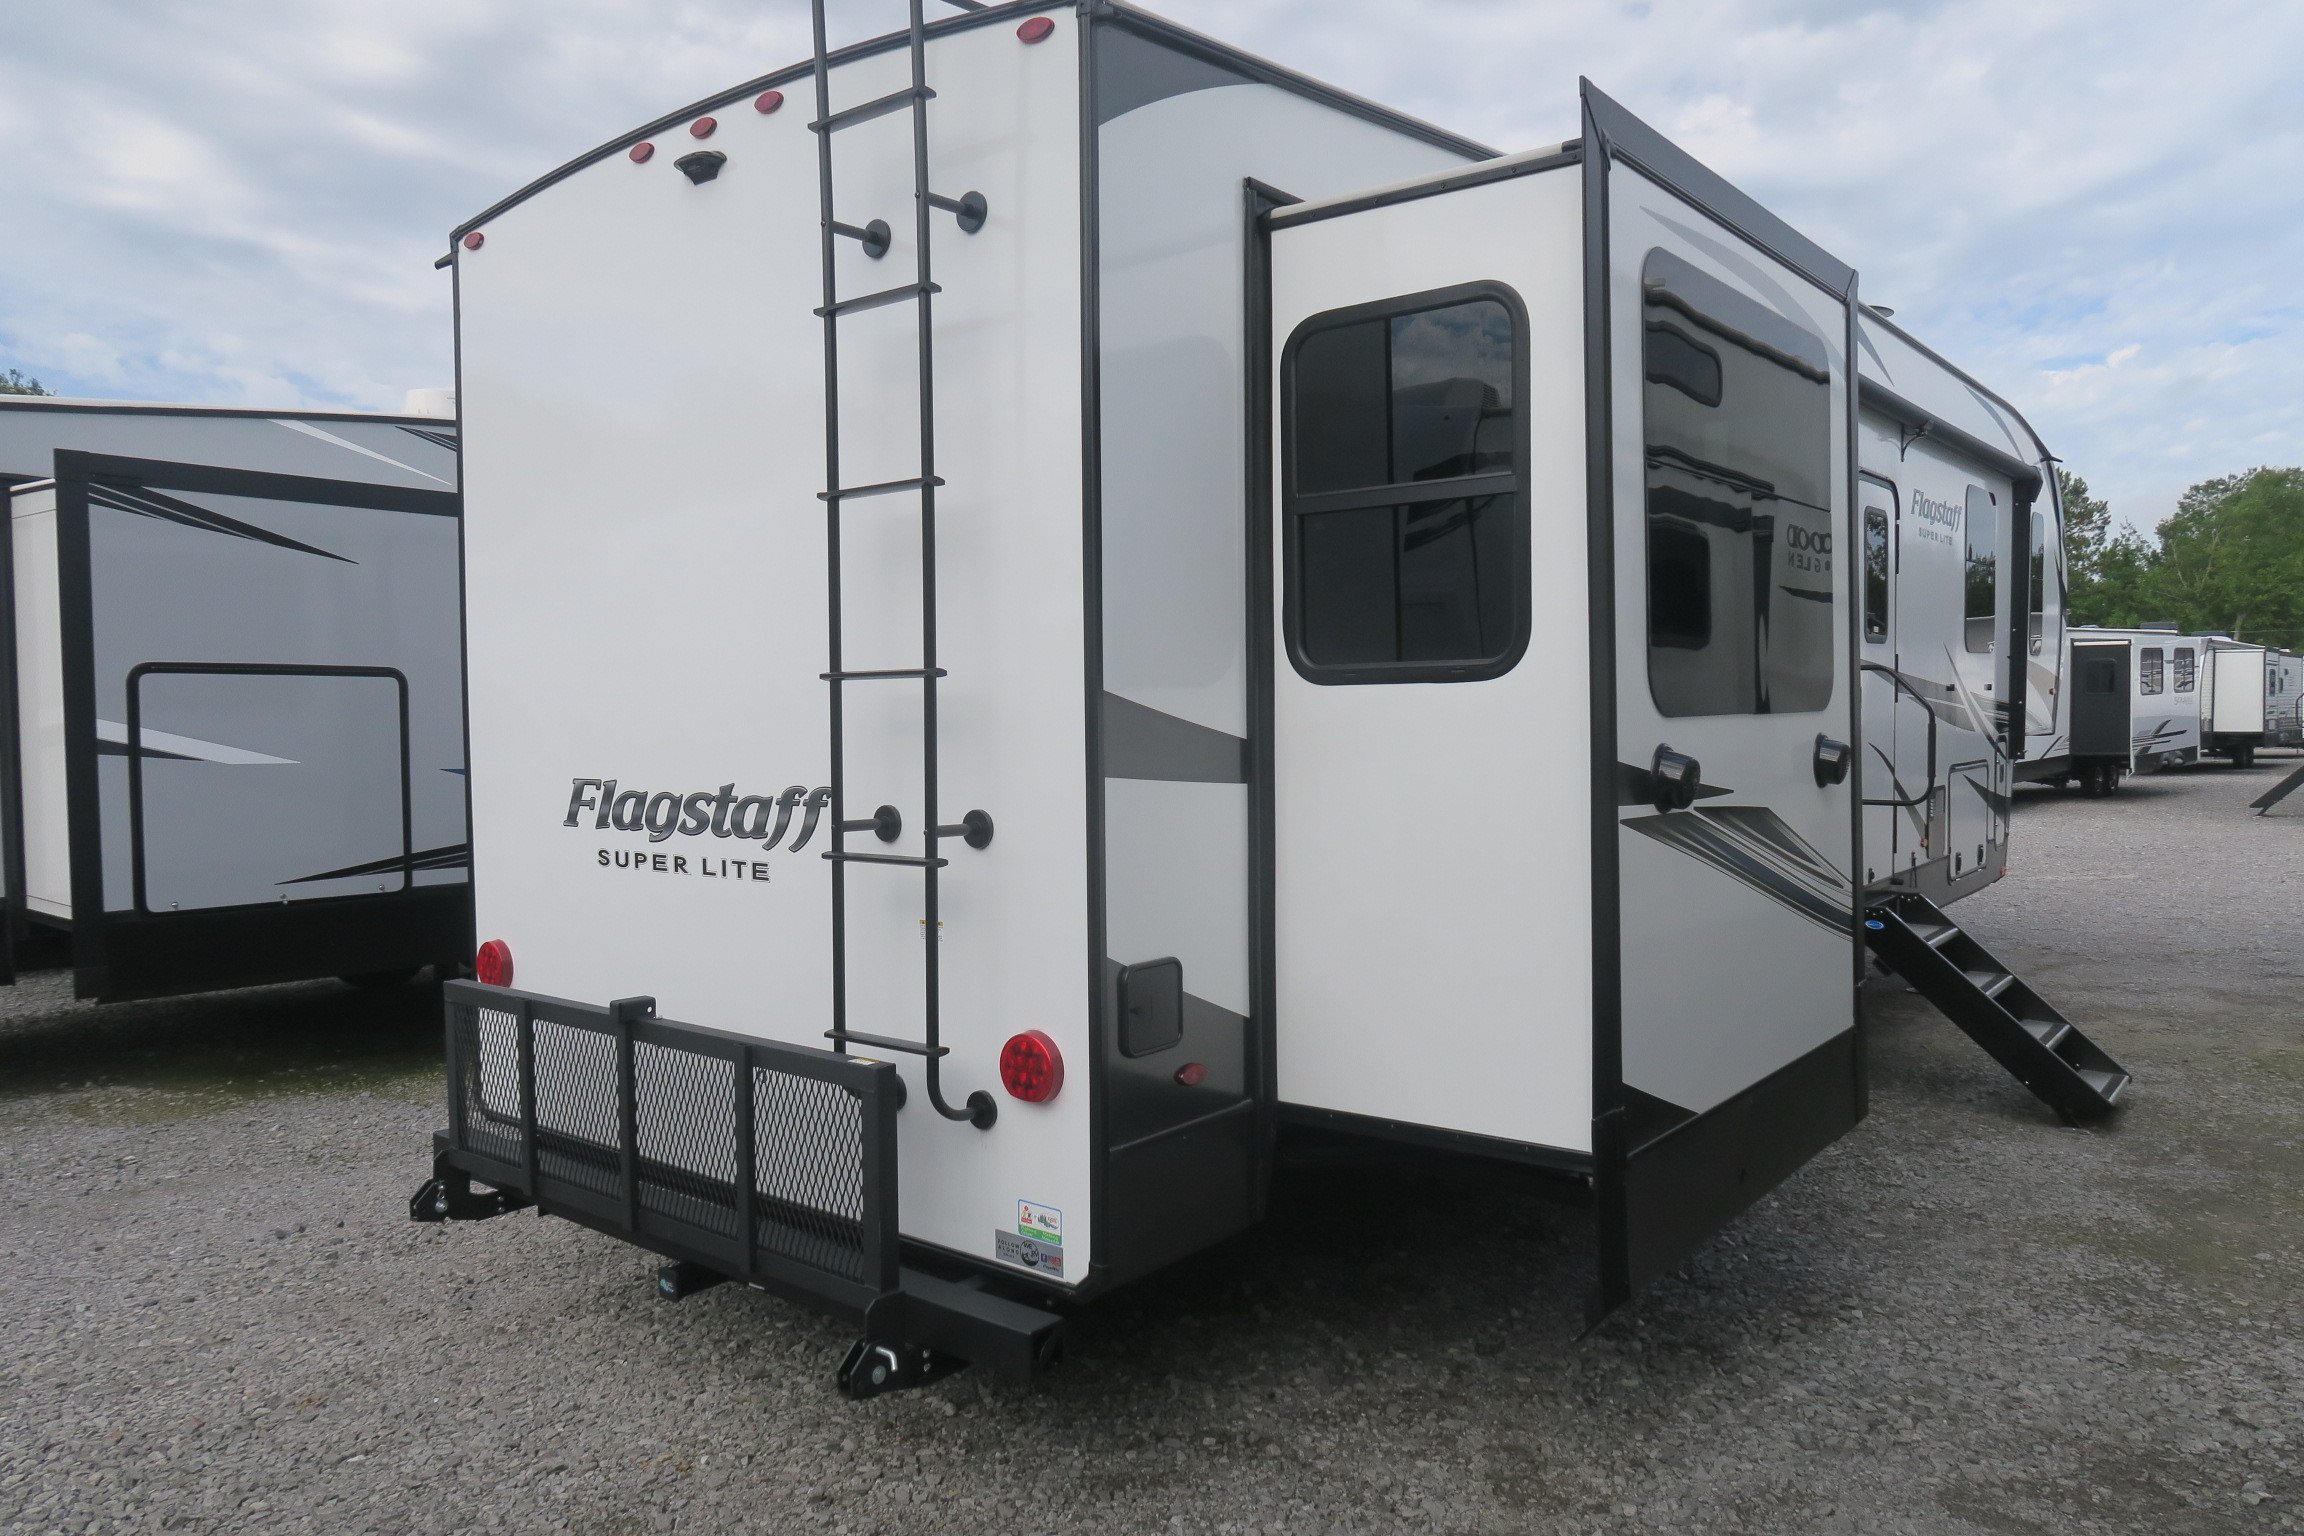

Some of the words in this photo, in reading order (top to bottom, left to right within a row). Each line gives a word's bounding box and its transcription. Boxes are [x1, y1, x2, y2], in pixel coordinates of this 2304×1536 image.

[1910, 488, 1962, 533] Flagstaff
[1918, 527, 1938, 542] SUPER
[1939, 533, 1953, 546] LITE
[563, 778, 831, 852] Flagstaff
[598, 849, 690, 875] SUPER
[702, 857, 770, 882] LITE
